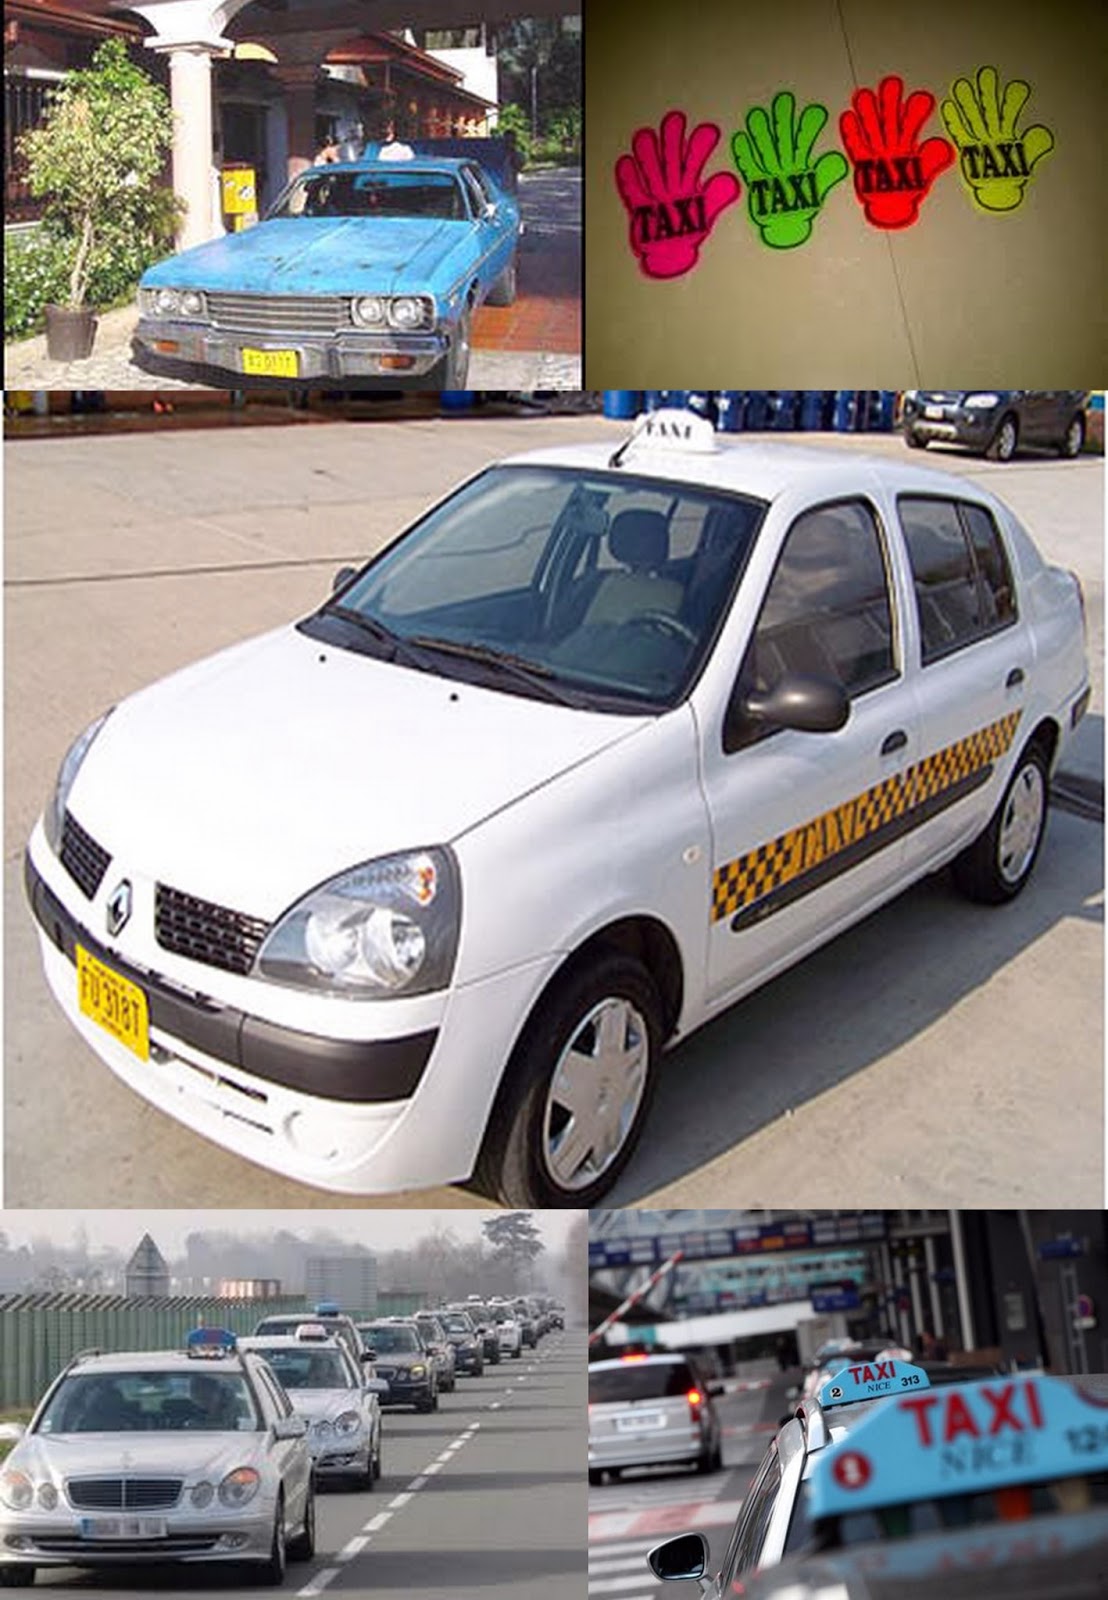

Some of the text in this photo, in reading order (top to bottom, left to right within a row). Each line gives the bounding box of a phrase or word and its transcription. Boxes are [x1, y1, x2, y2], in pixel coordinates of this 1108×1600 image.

[856, 155, 926, 194] TAXI
[963, 142, 1030, 179] TAXI
[752, 172, 821, 216] TAXI
[634, 194, 708, 244] TAXI
[644, 420, 692, 440] TAXI
[793, 797, 863, 871] TAXI
[831, 1375, 920, 1398] 2 NICE 313
[848, 1360, 896, 1385] TAXI
[897, 1377, 1046, 1448] TAXI
[939, 1431, 1033, 1478] NICE
